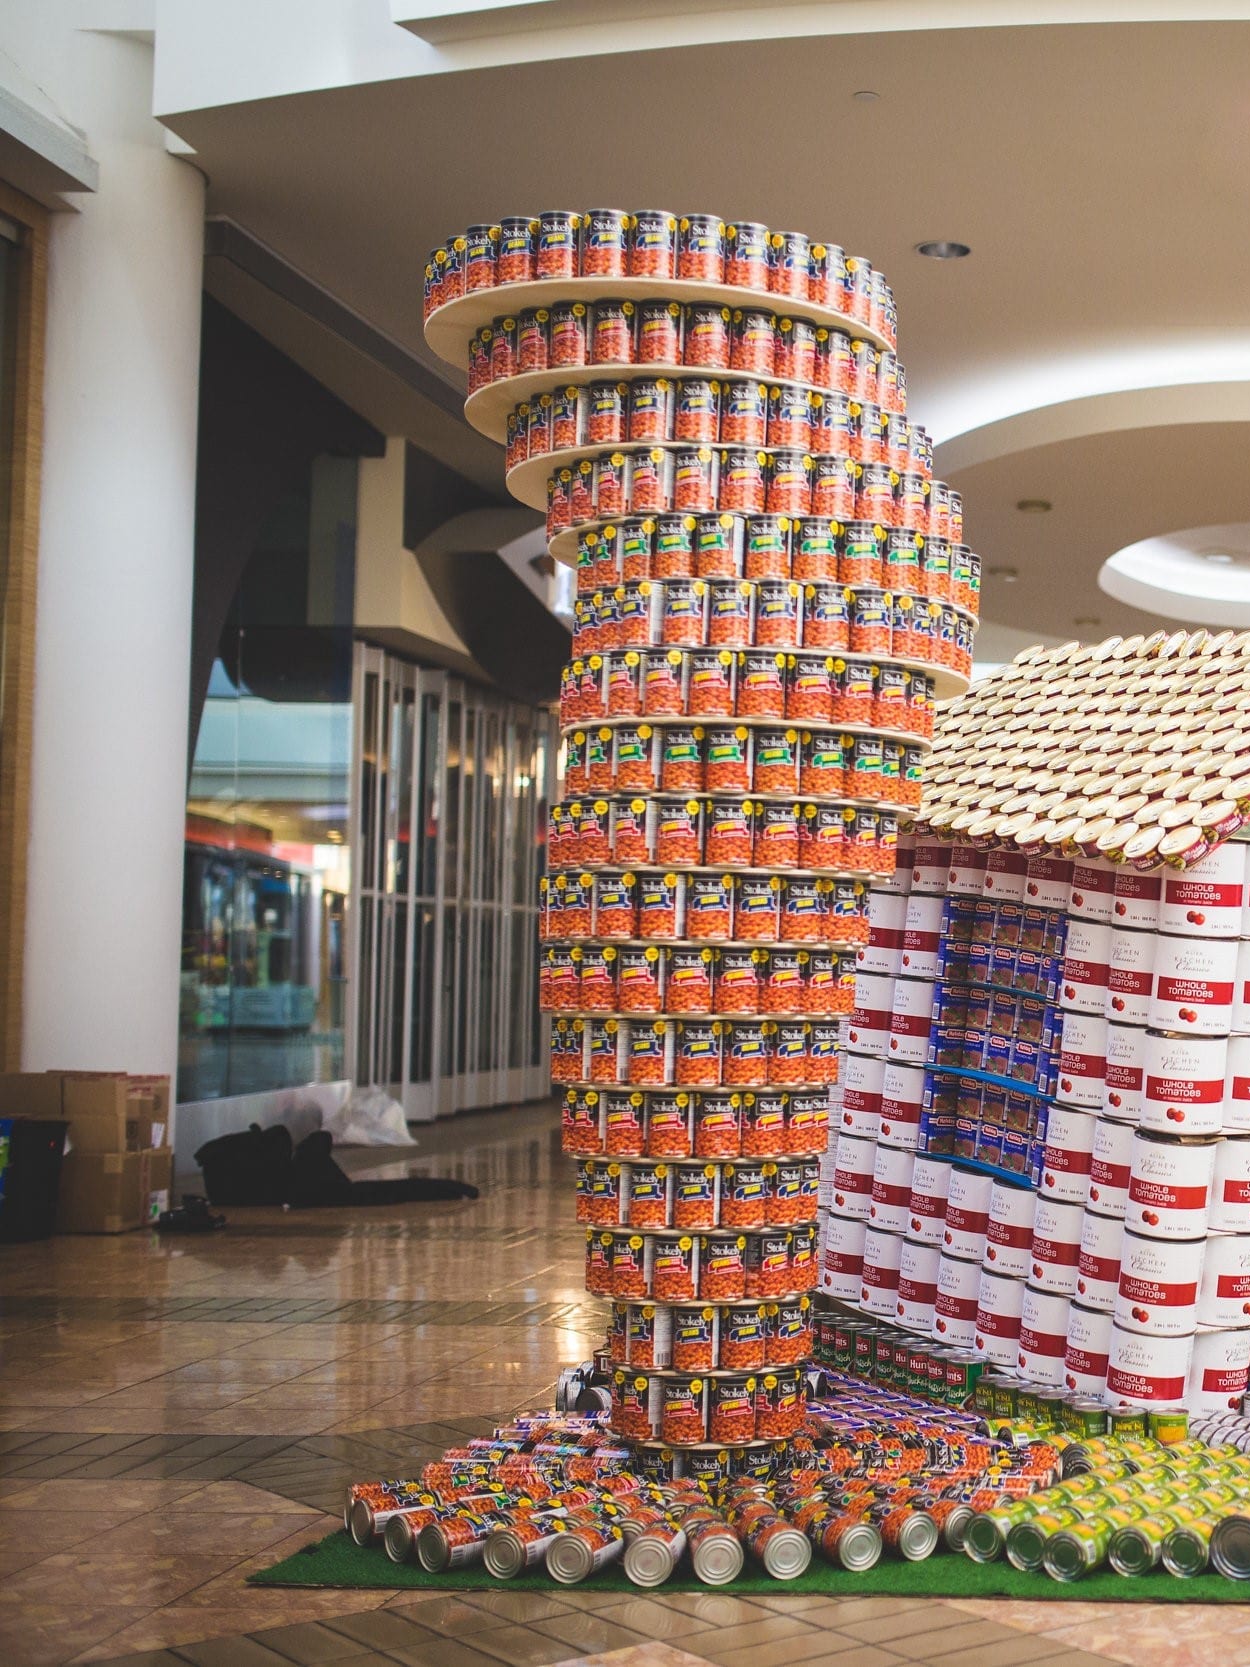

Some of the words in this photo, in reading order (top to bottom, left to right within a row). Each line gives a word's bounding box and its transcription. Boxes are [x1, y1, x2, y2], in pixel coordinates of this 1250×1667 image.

[542, 222, 571, 233] Stokely
[503, 228, 531, 239] Stokely
[1182, 884, 1214, 893] WHOLE
[1176, 889, 1221, 901] TOMATOES
[1175, 980, 1207, 990] WHOLE
[1168, 987, 1214, 998] TOMATOES
[1162, 1080, 1194, 1089] WHOLE
[1155, 1086, 1201, 1097] TOMATOES
[1140, 1183, 1169, 1194] WHOLE
[1135, 1187, 1177, 1203] TOMATOES
[655, 1245, 682, 1257] Stokely
[711, 1245, 740, 1258] Stokely
[1130, 1279, 1159, 1291] WHOLE
[1124, 1284, 1166, 1300] TOMATOES
[677, 1316, 705, 1328] Stokely
[733, 1314, 760, 1326] Stokely
[681, 1328, 700, 1337] BEANS
[738, 1326, 756, 1337] BEANS
[910, 1359, 927, 1369] Hun
[1117, 1372, 1146, 1384] WHOLE
[1112, 1377, 1153, 1393] TOMATOES
[666, 1388, 693, 1399] Stokely
[720, 1387, 749, 1399] Stokely
[721, 1401, 739, 1410] BEANS
[692, 1459, 720, 1470] Stokely
[748, 1454, 771, 1465] Stokel
